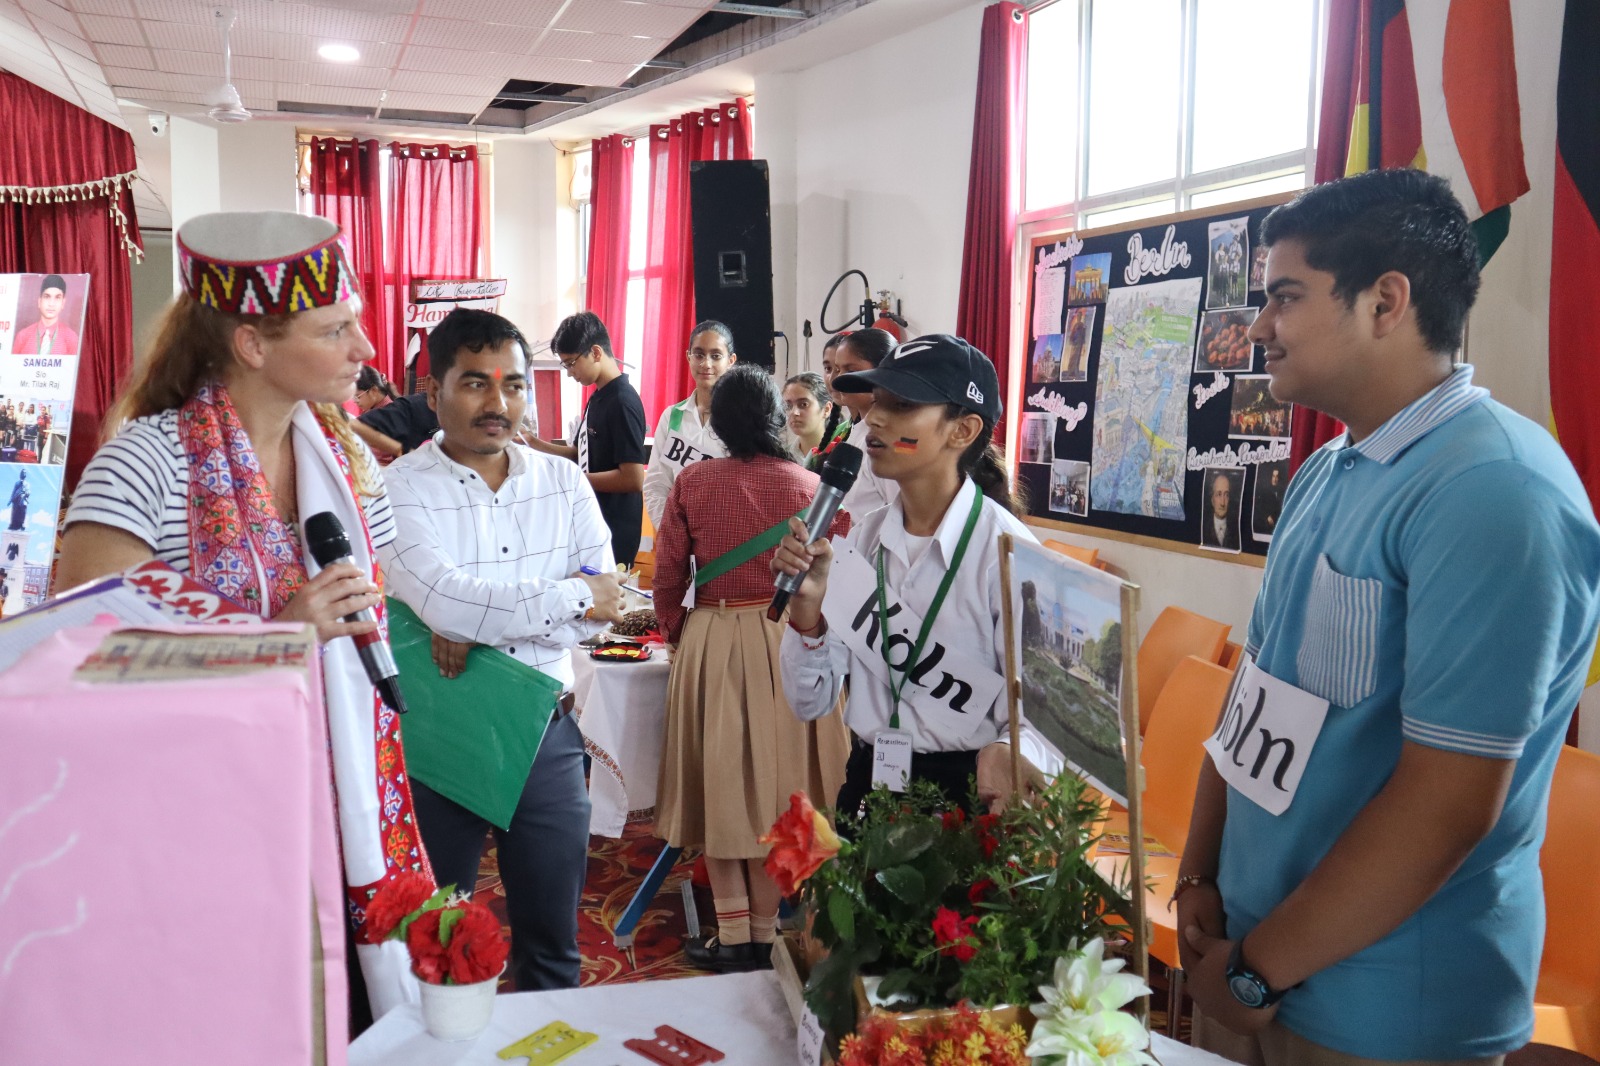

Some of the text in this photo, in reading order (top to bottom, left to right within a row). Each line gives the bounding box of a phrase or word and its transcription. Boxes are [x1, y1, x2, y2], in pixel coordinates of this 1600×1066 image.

[1126, 225, 1190, 282] Berlin
[23, 358, 62, 368] SANGAM
[20, 380, 60, 390] Mr. Tilak Raj
[664, 436, 714, 468] BE
[851, 587, 969, 715] Köln
